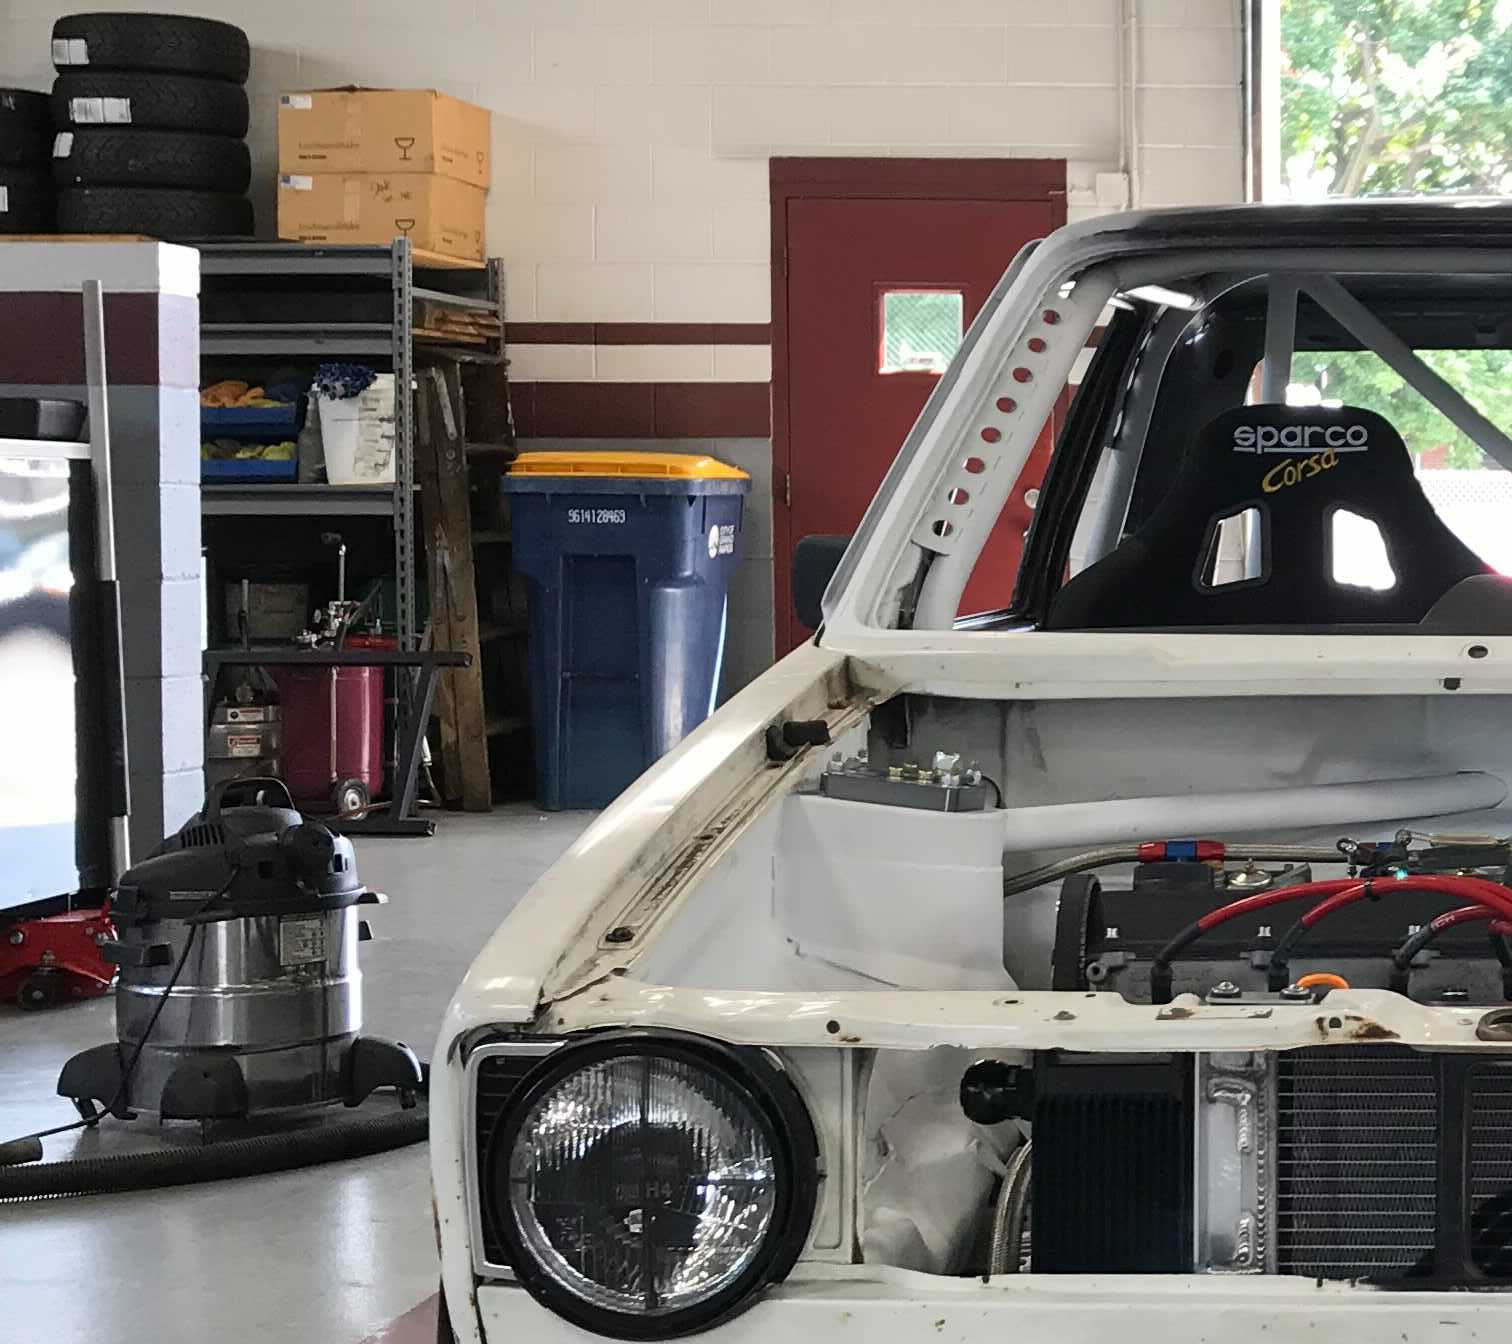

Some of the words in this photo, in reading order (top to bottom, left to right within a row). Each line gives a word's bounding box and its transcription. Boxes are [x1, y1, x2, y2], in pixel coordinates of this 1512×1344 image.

[1233, 425, 1368, 454] sparco
[1262, 448, 1339, 492] Corsa
[645, 1181, 673, 1198] H4
